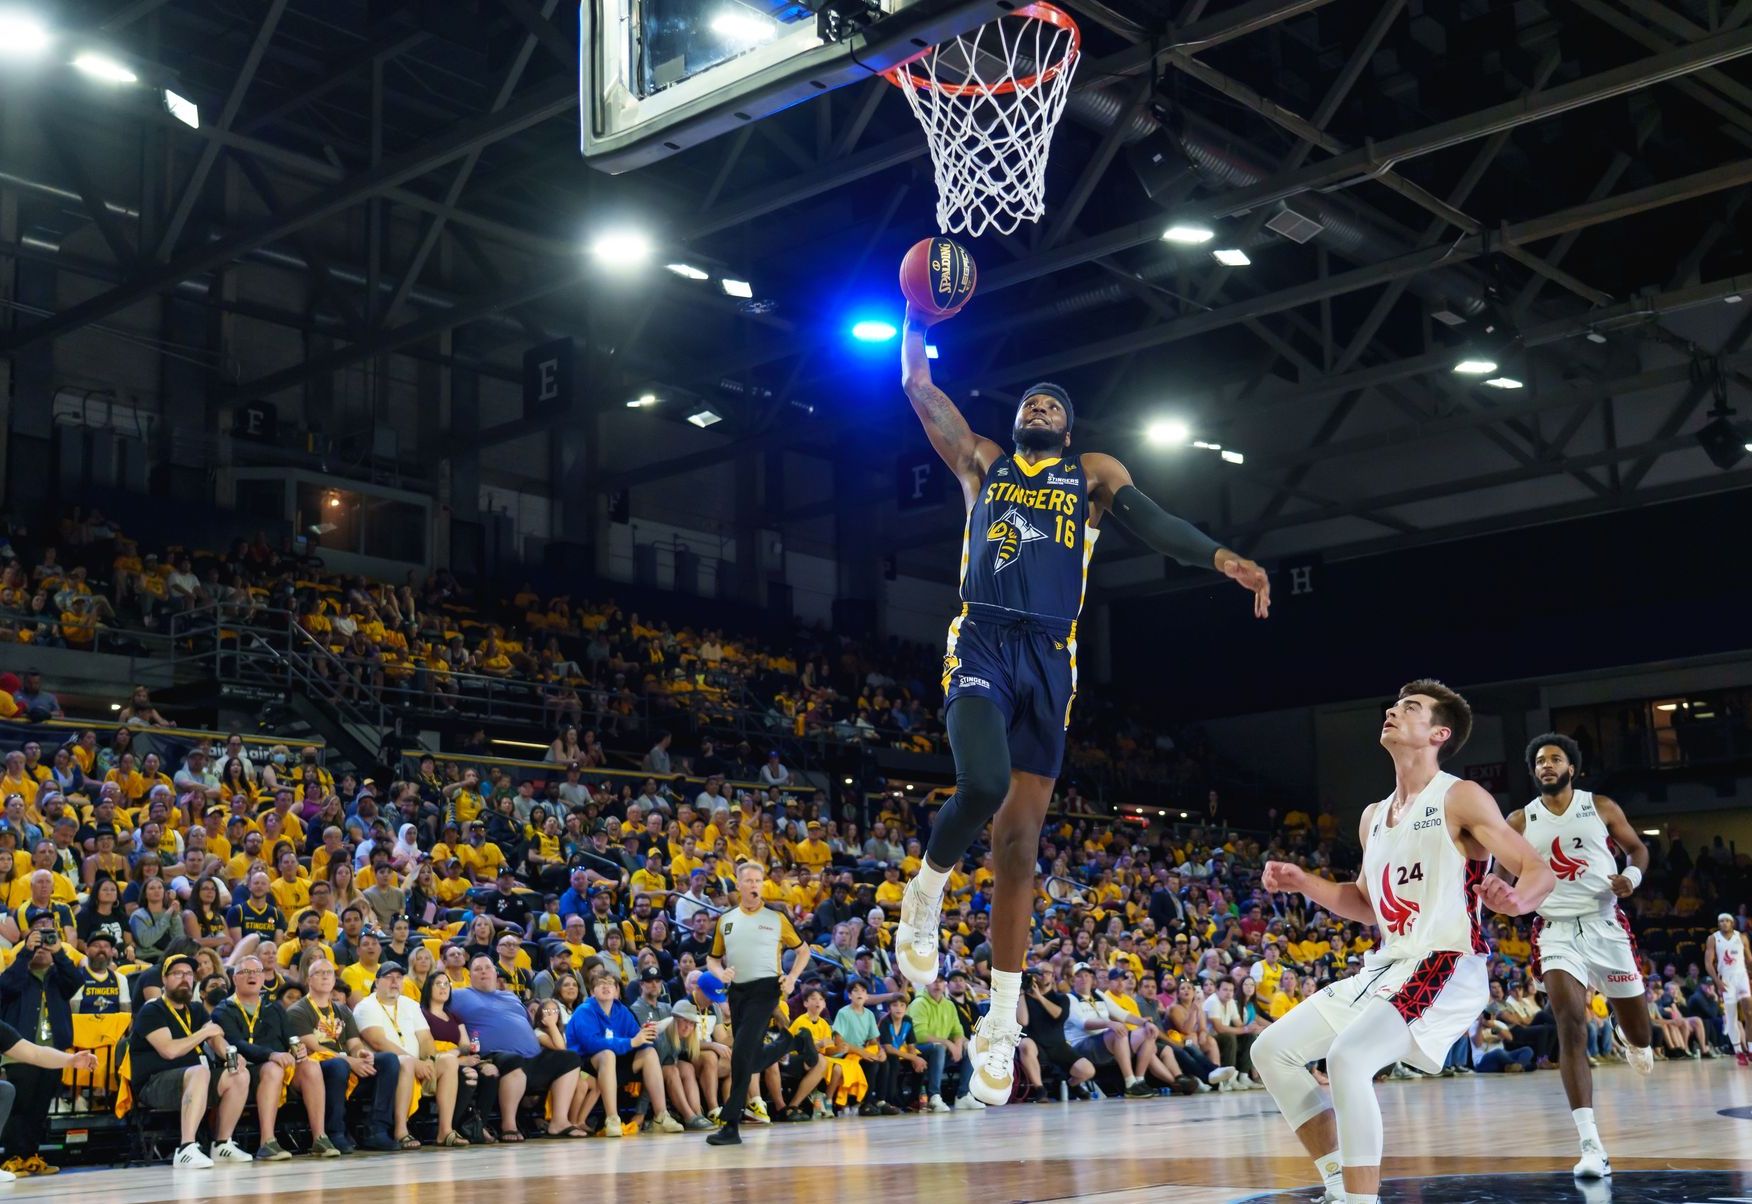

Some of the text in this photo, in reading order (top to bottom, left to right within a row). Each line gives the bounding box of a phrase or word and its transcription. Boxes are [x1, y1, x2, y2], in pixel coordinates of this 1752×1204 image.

[938, 243, 952, 294] SPALDING
[538, 357, 558, 401] E
[912, 464, 930, 499] F
[1047, 476, 1078, 484] STINGERS
[984, 482, 1078, 516] STINGERS
[1055, 515, 1076, 549] 16
[1289, 566, 1313, 595] H
[959, 676, 990, 688] STINGERS
[1470, 764, 1503, 779] EXIT
[1421, 817, 1441, 829] ZENO
[1572, 837, 1583, 849] 2
[1397, 862, 1424, 885] 24
[245, 921, 275, 931] STINGERS
[86, 987, 118, 996] STINGERS
